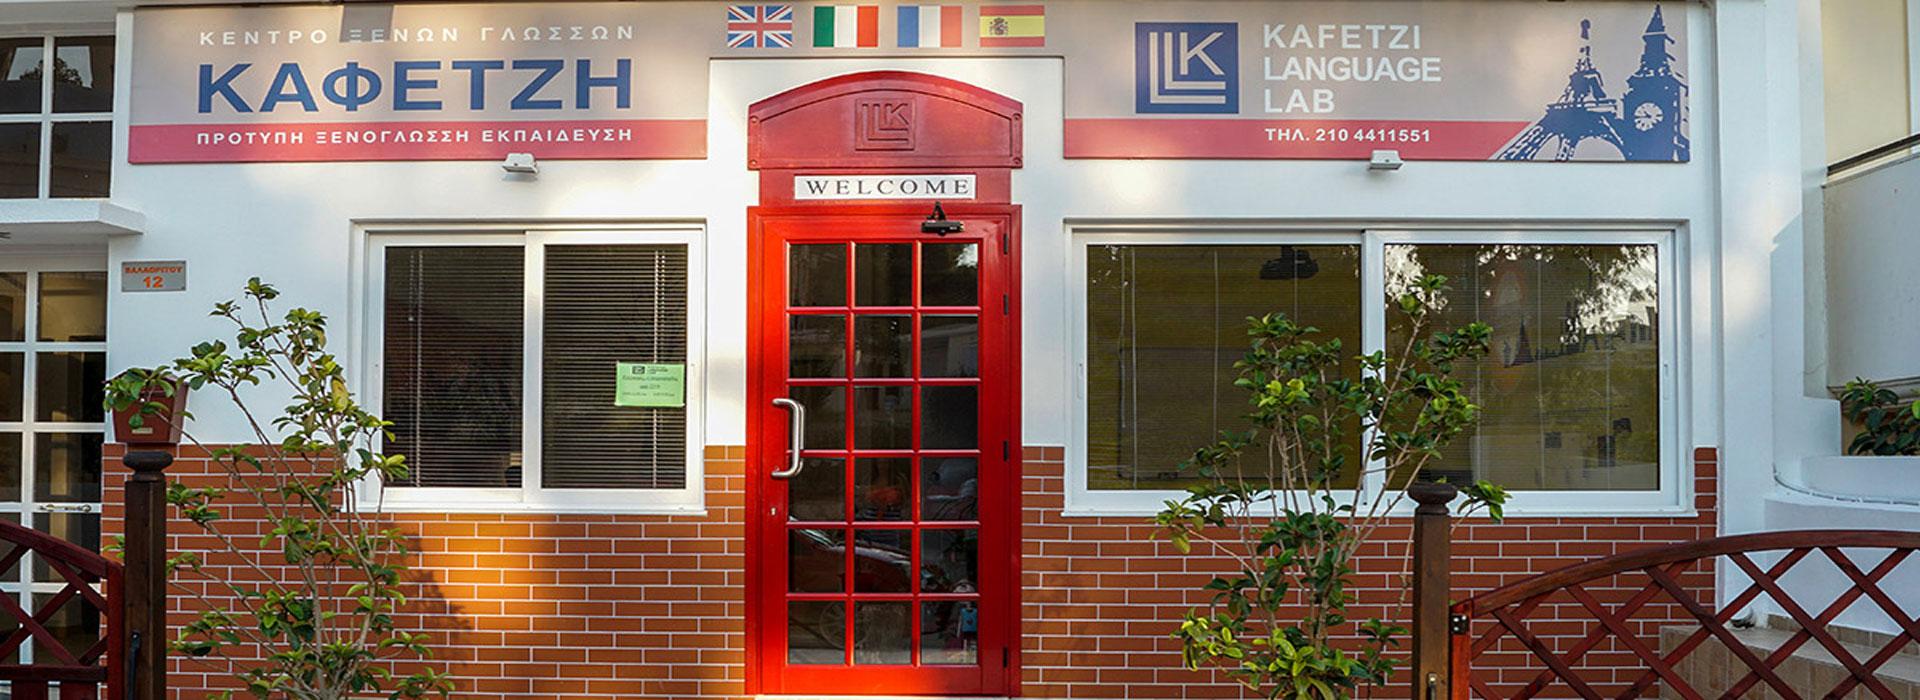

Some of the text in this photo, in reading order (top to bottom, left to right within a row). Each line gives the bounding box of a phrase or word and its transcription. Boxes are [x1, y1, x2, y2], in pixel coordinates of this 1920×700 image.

[200, 25, 633, 46] ΚΕΝΤΡΟ ΞΕΝΩΝ ΓΛΩΣΣΩΝ
[1263, 24, 1421, 49] KAFETZI
[1263, 56, 1442, 82] LANGUAGE
[198, 58, 632, 114] ΚΑΦΕΤΖΗ
[1263, 88, 1336, 113] LAB
[197, 128, 632, 145] ΠΡΟΤΥΠΗ ΞΕΝΟΓΛΩΣΣΗ ΕΚΠΑΙΔΕΥΣΗ
[1264, 128, 1431, 142] ΤΗΛ. 210 4411551
[805, 178, 970, 196] WELCOME
[143, 276, 163, 288] 12
